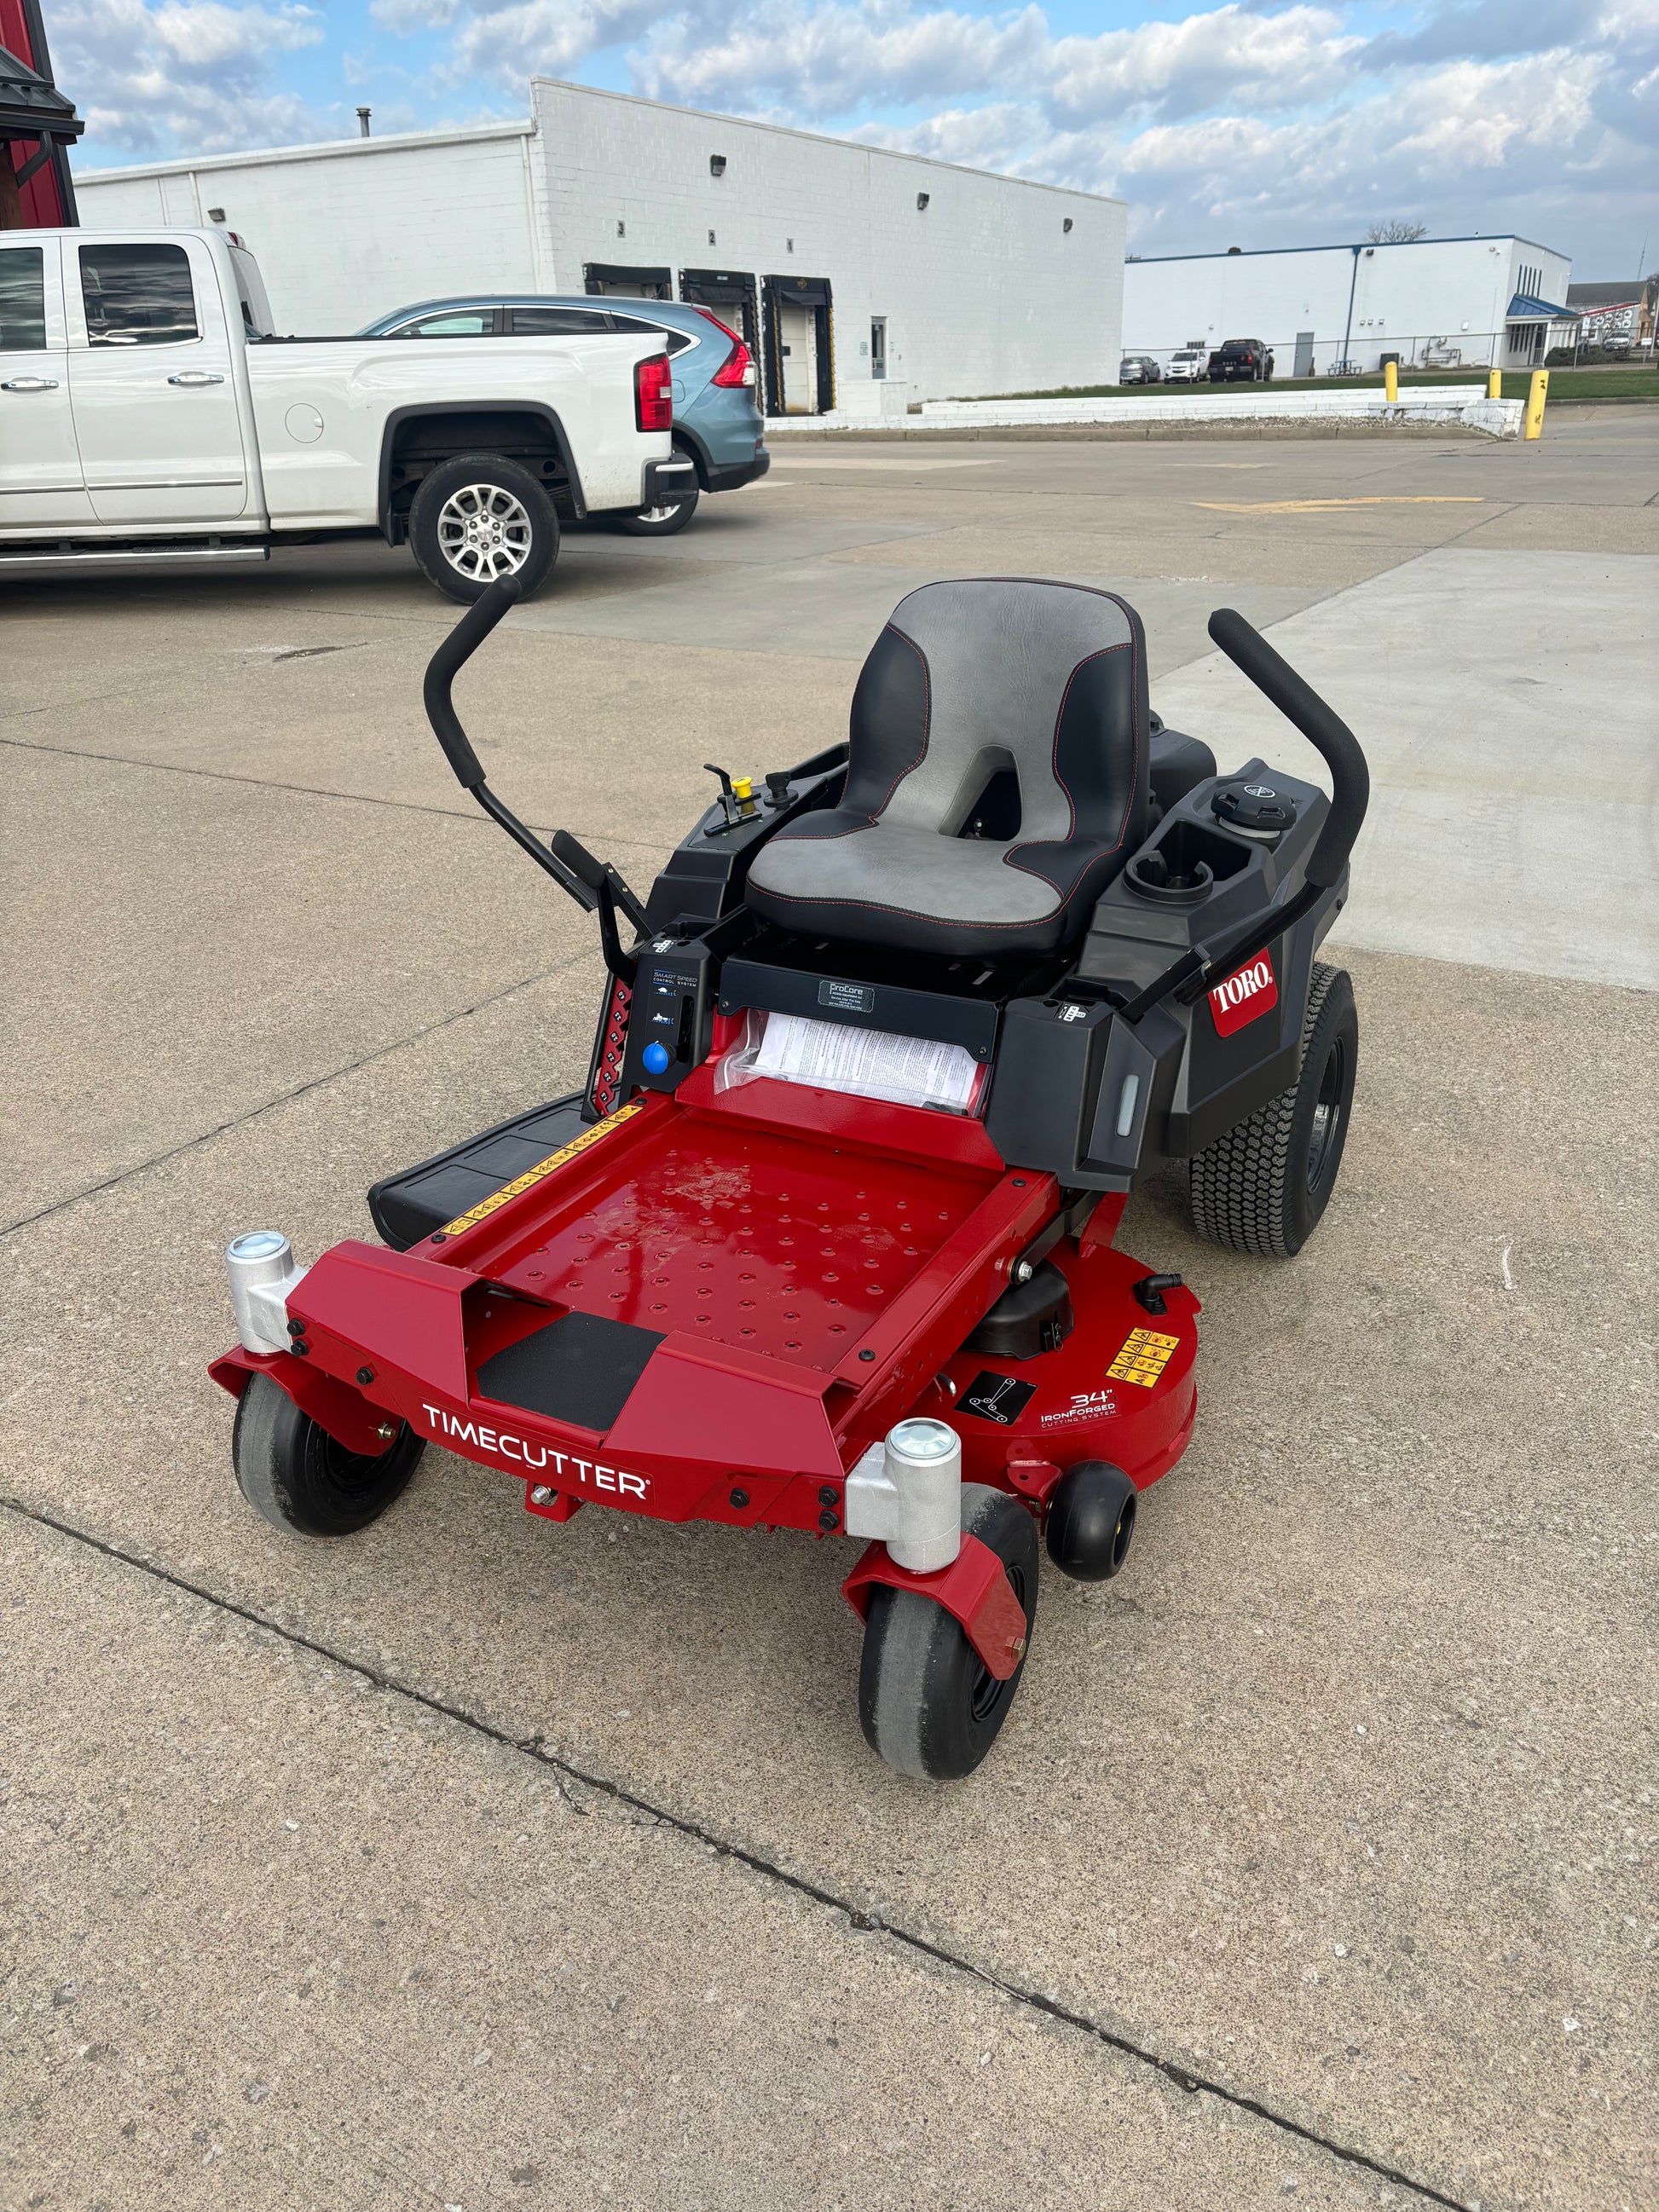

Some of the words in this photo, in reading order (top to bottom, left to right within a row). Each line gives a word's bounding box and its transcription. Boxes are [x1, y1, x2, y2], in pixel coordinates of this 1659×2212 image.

[617, 222, 625, 235] 3
[708, 232, 715, 244] 2
[653, 971, 676, 980] SMART
[676, 974, 697, 983] SPEED
[1212, 962, 1269, 1014] TORO
[1070, 1389, 1113, 1409] 34"
[1041, 1418, 1078, 1428] CUTTING
[1082, 1410, 1117, 1421] SYSTEM
[422, 1403, 646, 1500] TIMECUTTER
